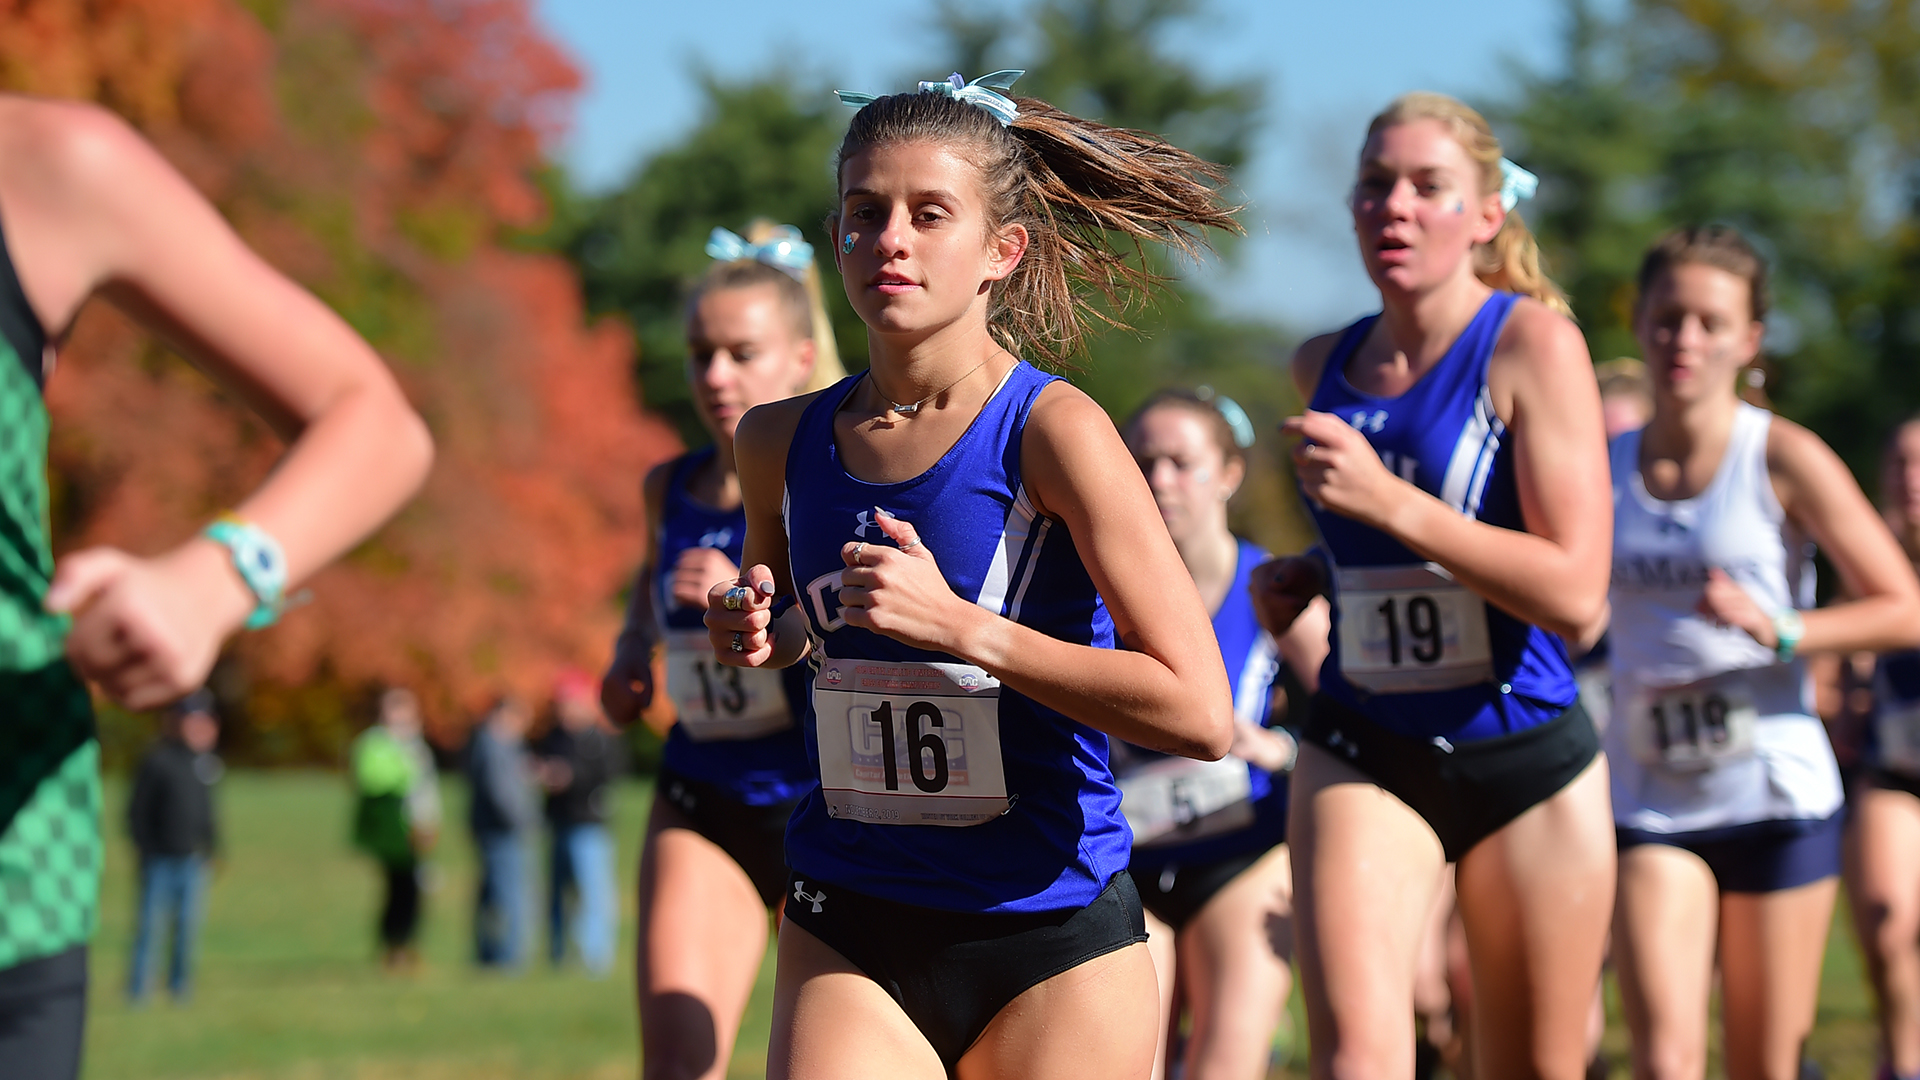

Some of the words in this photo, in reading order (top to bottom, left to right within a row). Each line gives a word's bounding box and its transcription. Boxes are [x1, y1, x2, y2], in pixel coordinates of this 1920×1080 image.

[1378, 595, 1443, 664] 19
[693, 659, 747, 714] 13
[870, 700, 949, 793] 16
[882, 808, 900, 820] 2019
